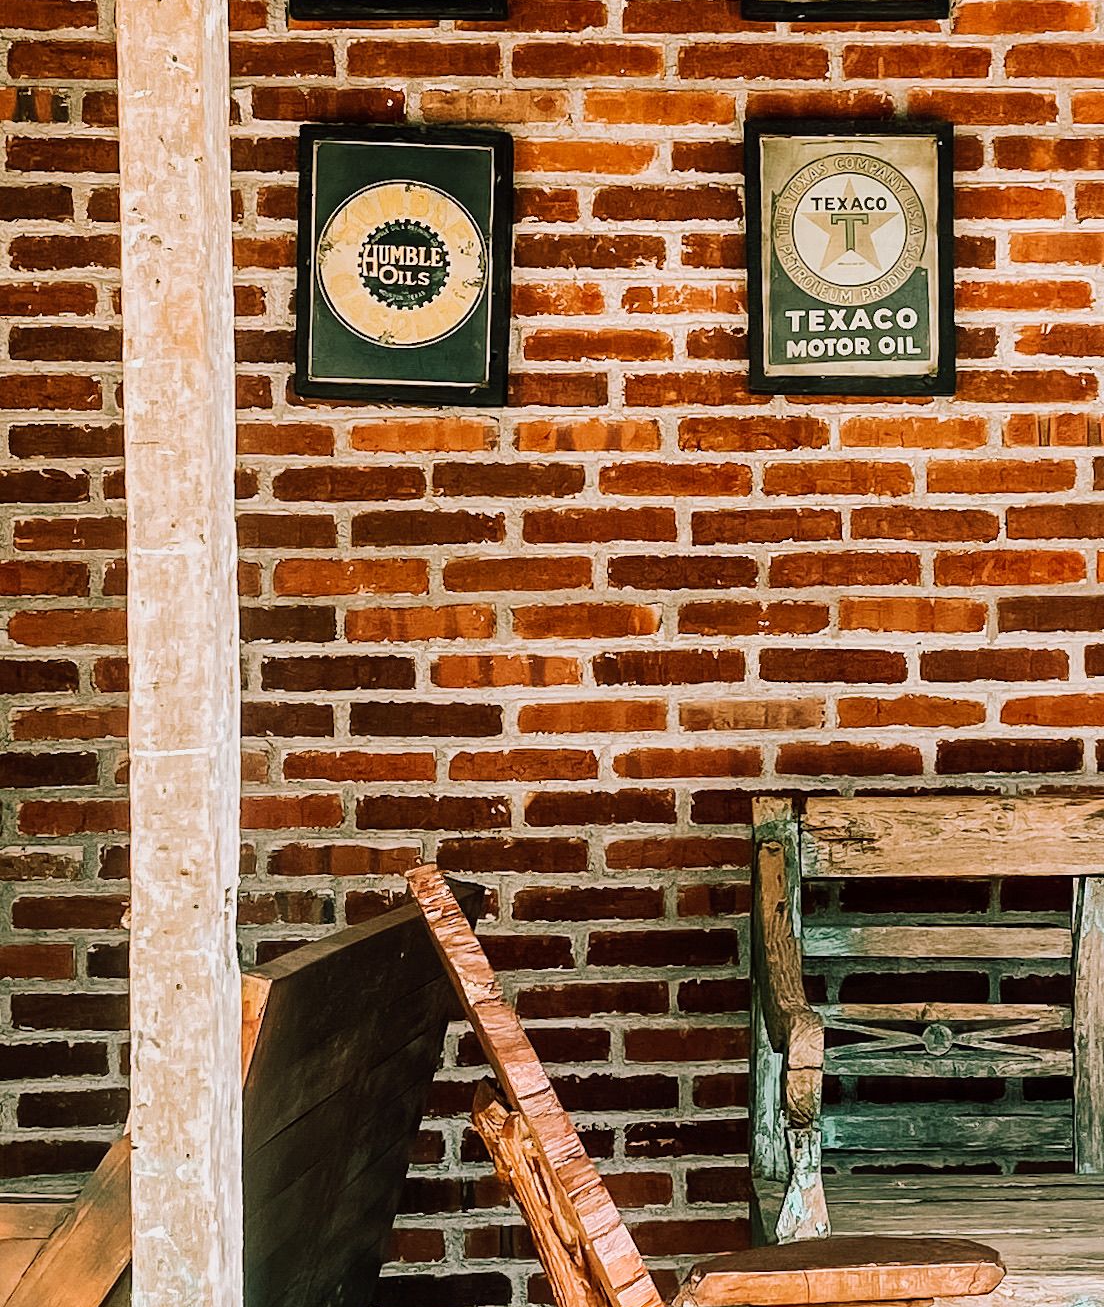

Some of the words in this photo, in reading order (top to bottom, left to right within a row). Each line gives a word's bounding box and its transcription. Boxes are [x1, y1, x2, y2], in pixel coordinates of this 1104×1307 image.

[783, 161, 828, 203] TEXAS
[834, 156, 910, 194] COMPANY
[810, 196, 888, 211] TEXACO
[775, 204, 793, 237] THE
[831, 213, 869, 252] T
[362, 244, 445, 277] HUMBLE
[378, 265, 431, 286] OILS
[778, 244, 853, 303] PETROLEUM
[785, 307, 918, 333] TEXACO
[786, 337, 871, 359] MOTOR
[878, 335, 922, 355] OIL
